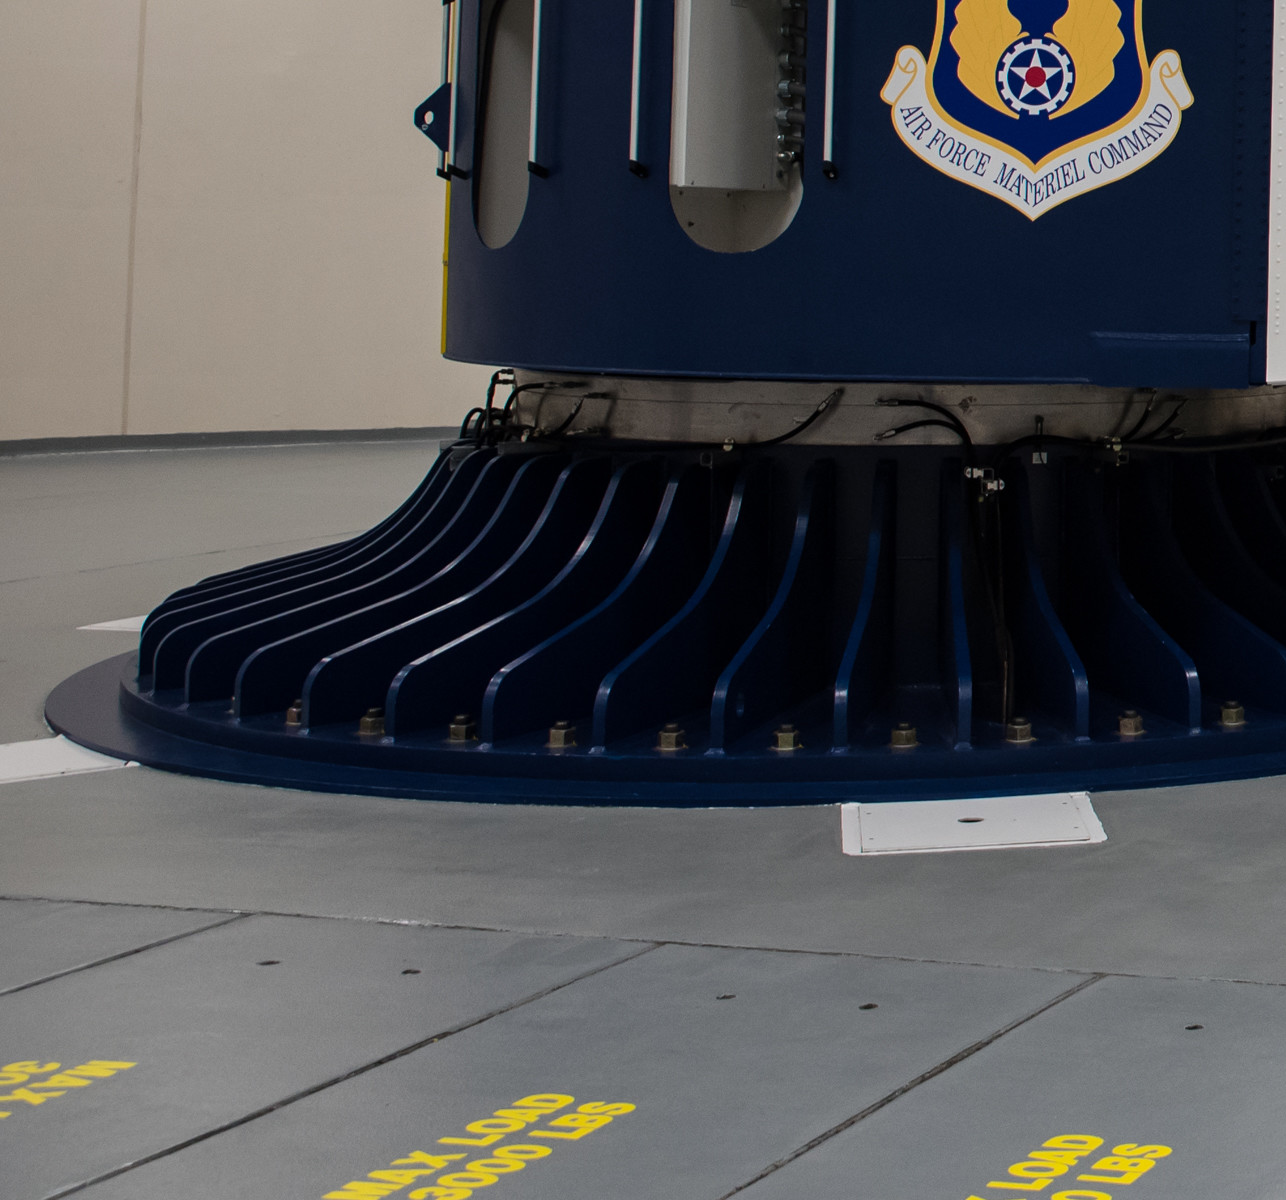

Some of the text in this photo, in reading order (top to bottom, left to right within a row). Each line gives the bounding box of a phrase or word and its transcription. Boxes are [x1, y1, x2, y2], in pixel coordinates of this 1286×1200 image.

[900, 103, 1174, 208] AIR FORCE MATERIEL COMMAND
[0, 1060, 138, 1106] MAX
[322, 1093, 575, 1200] MAX LOAD
[408, 1101, 636, 1200] 3000 LBS
[986, 1134, 1104, 1191] LOAD
[1076, 1143, 1173, 1185] LBS
